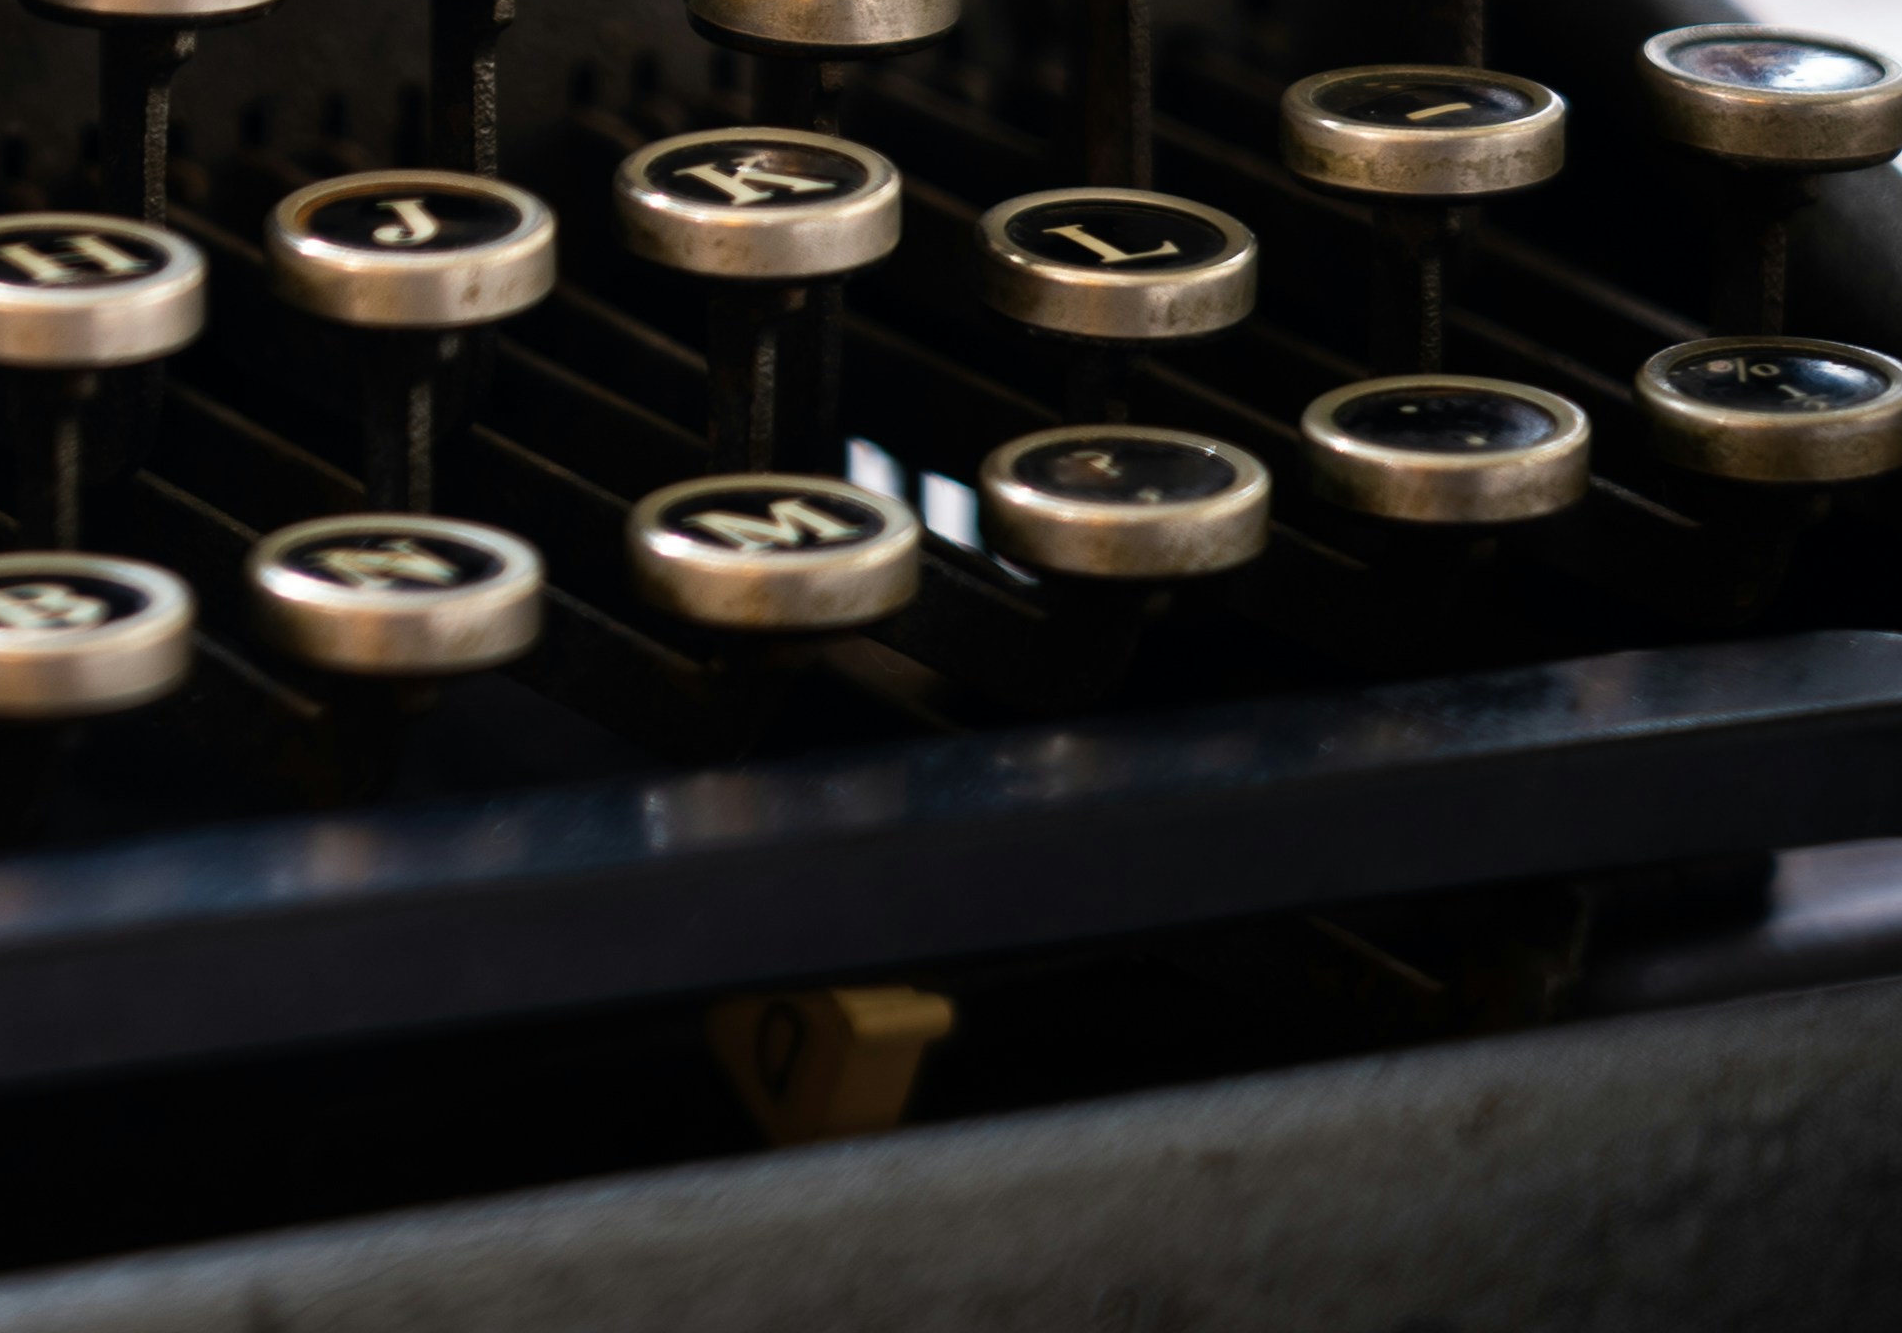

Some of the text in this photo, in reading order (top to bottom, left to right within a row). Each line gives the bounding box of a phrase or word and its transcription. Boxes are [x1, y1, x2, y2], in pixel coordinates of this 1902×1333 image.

[673, 150, 838, 207] K
[371, 199, 440, 247] J
[1041, 223, 1180, 265] L
[677, 497, 863, 553] M
